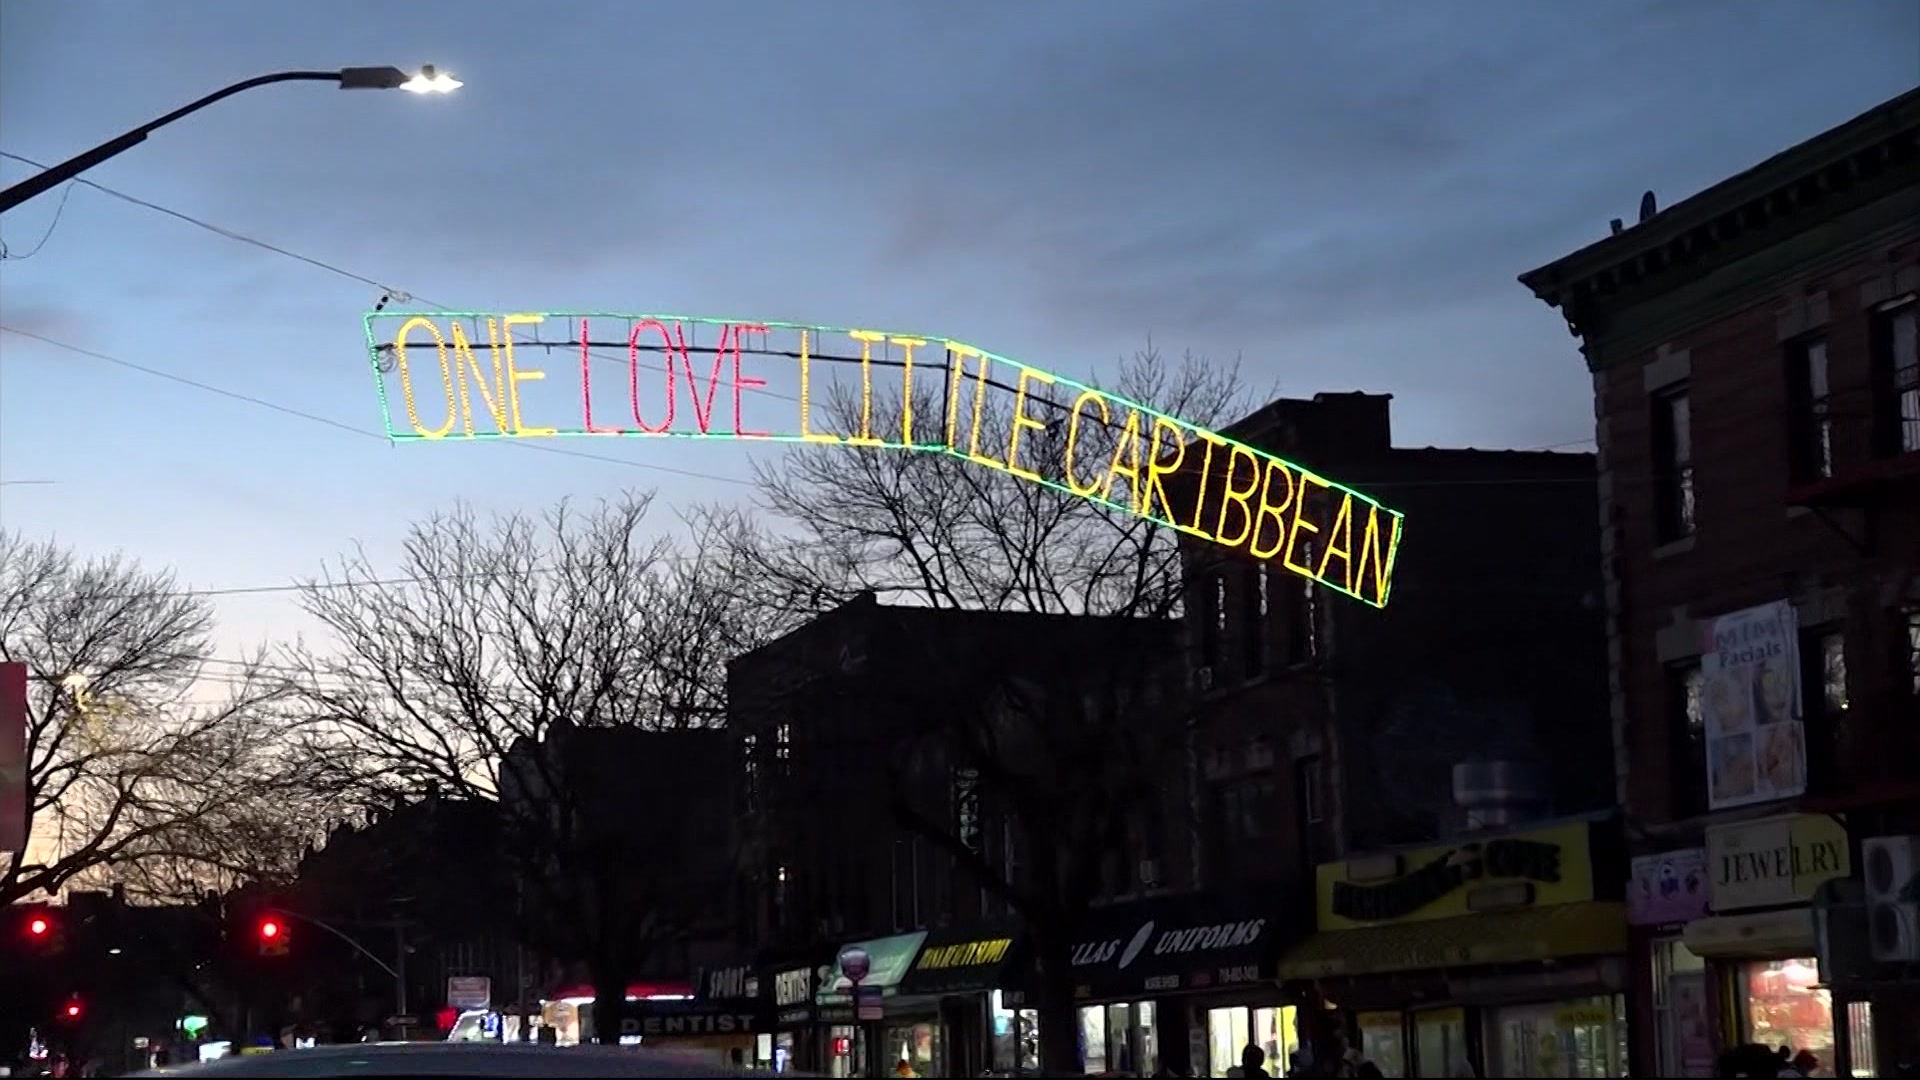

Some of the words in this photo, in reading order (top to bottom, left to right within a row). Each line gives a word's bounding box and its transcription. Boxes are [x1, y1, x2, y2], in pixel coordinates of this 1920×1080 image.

[396, 313, 556, 439] ONE
[578, 317, 772, 437] LOVE
[799, 328, 1055, 481] LITTLE
[1065, 389, 1403, 609] CARIBBEAN
[1716, 838, 1843, 886] JEWELRY
[1072, 938, 1121, 967] LLAS
[1153, 918, 1266, 956] UNIFORMS
[620, 1013, 755, 1034] DENTIST
